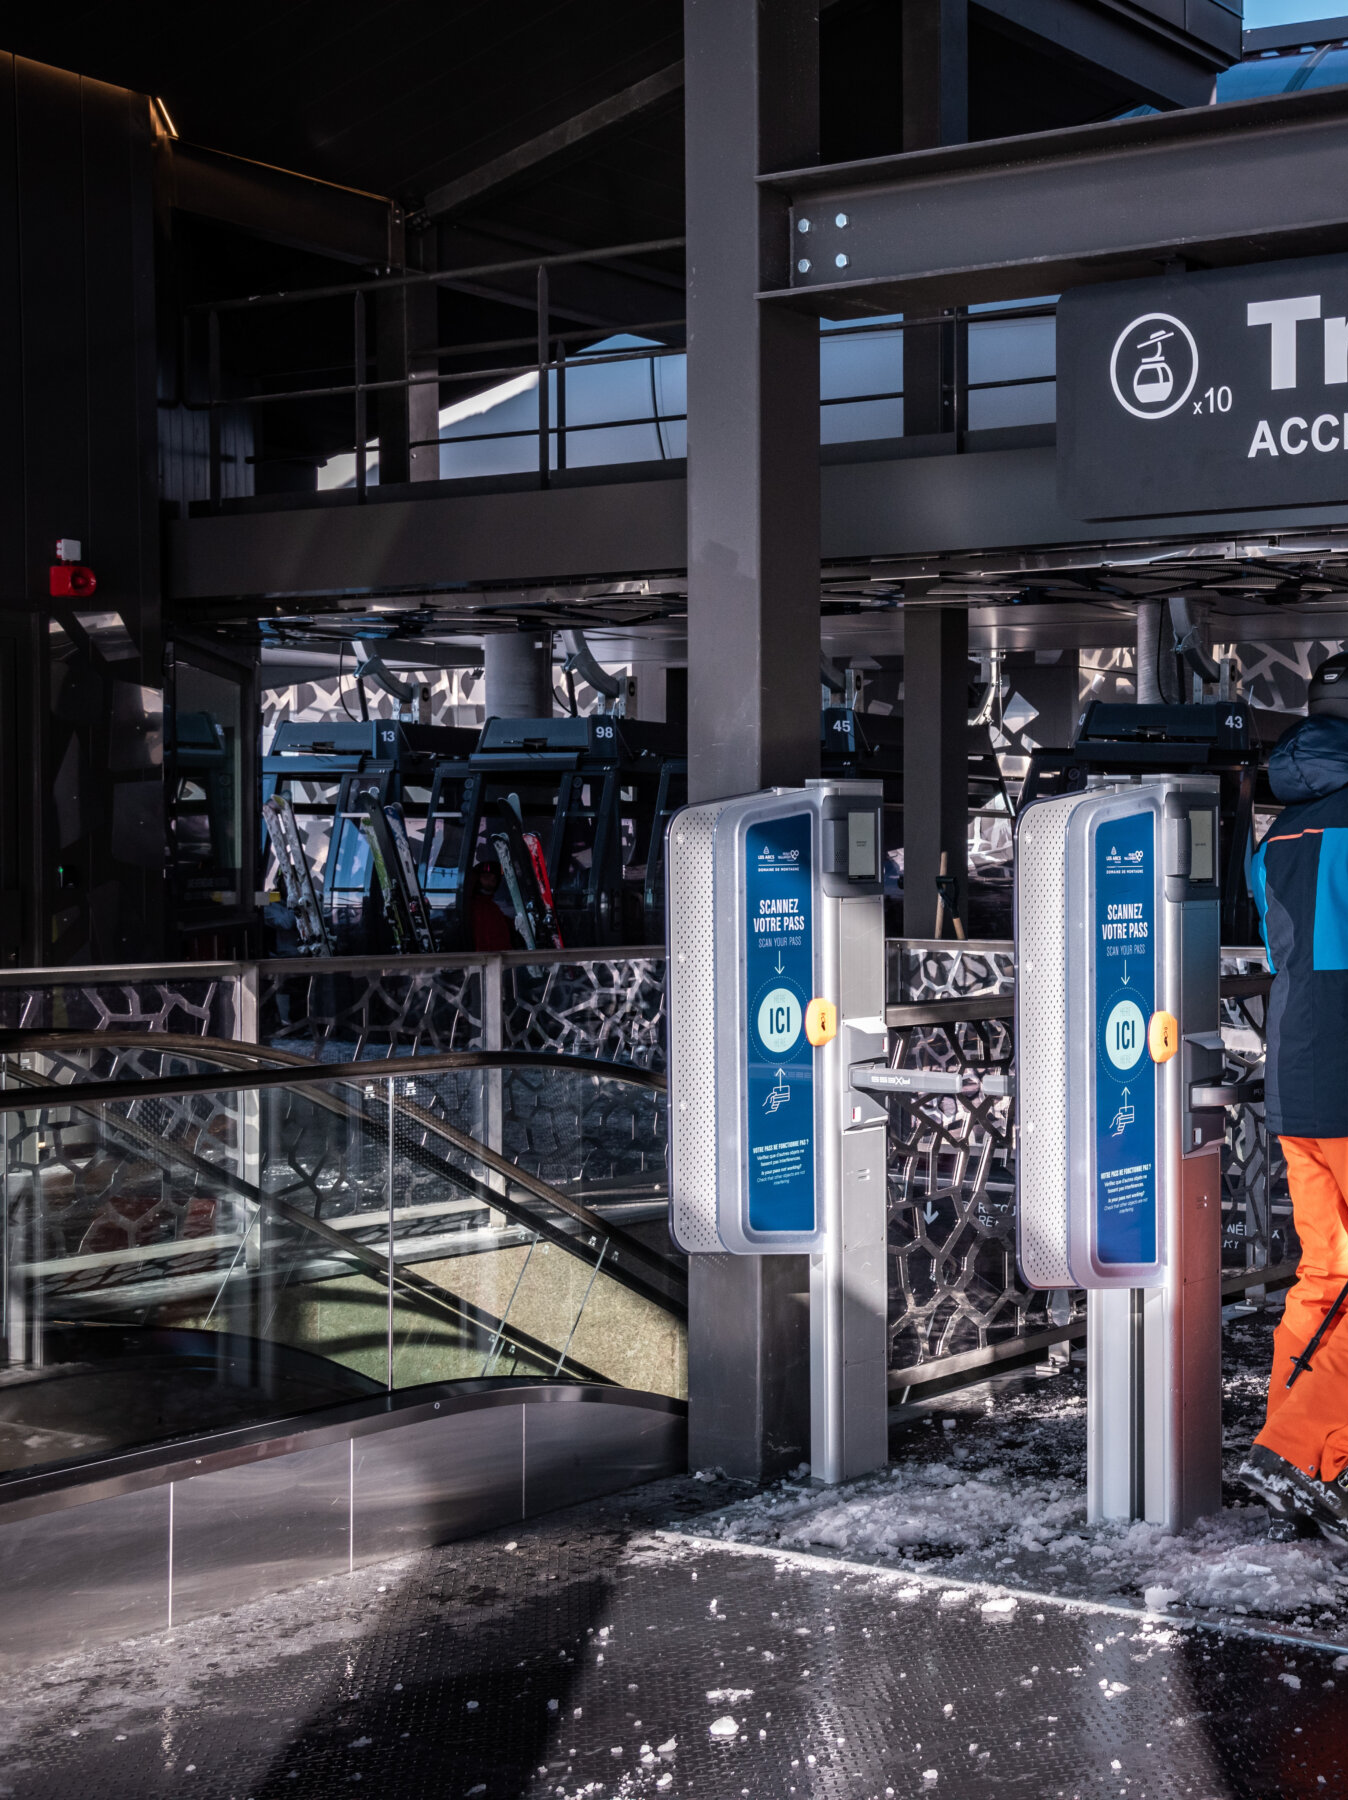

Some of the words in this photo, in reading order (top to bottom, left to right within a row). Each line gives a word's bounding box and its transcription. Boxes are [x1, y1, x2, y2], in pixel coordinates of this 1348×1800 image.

[1192, 385, 1233, 415] x10
[832, 720, 851, 733] 45
[1225, 715, 1243, 729] 43
[380, 731, 395, 743] 13
[595, 726, 614, 739] 98
[759, 898, 799, 915] SCANNEZ
[1107, 903, 1143, 920] SCANNEZ
[753, 916, 782, 933] VOTRE
[783, 915, 805, 931] PASS
[1101, 922, 1127, 940] VOTRE
[1129, 922, 1148, 938] PASS
[758, 937, 773, 948] SCAN
[774, 936, 788, 947] YOUR
[789, 935, 802, 946] PASS
[1106, 945, 1119, 957] SCAN
[1120, 944, 1132, 956] YOUR
[1133, 943, 1146, 955] PASS
[769, 1006, 790, 1034] ICI
[1116, 1020, 1135, 1050] ICI
